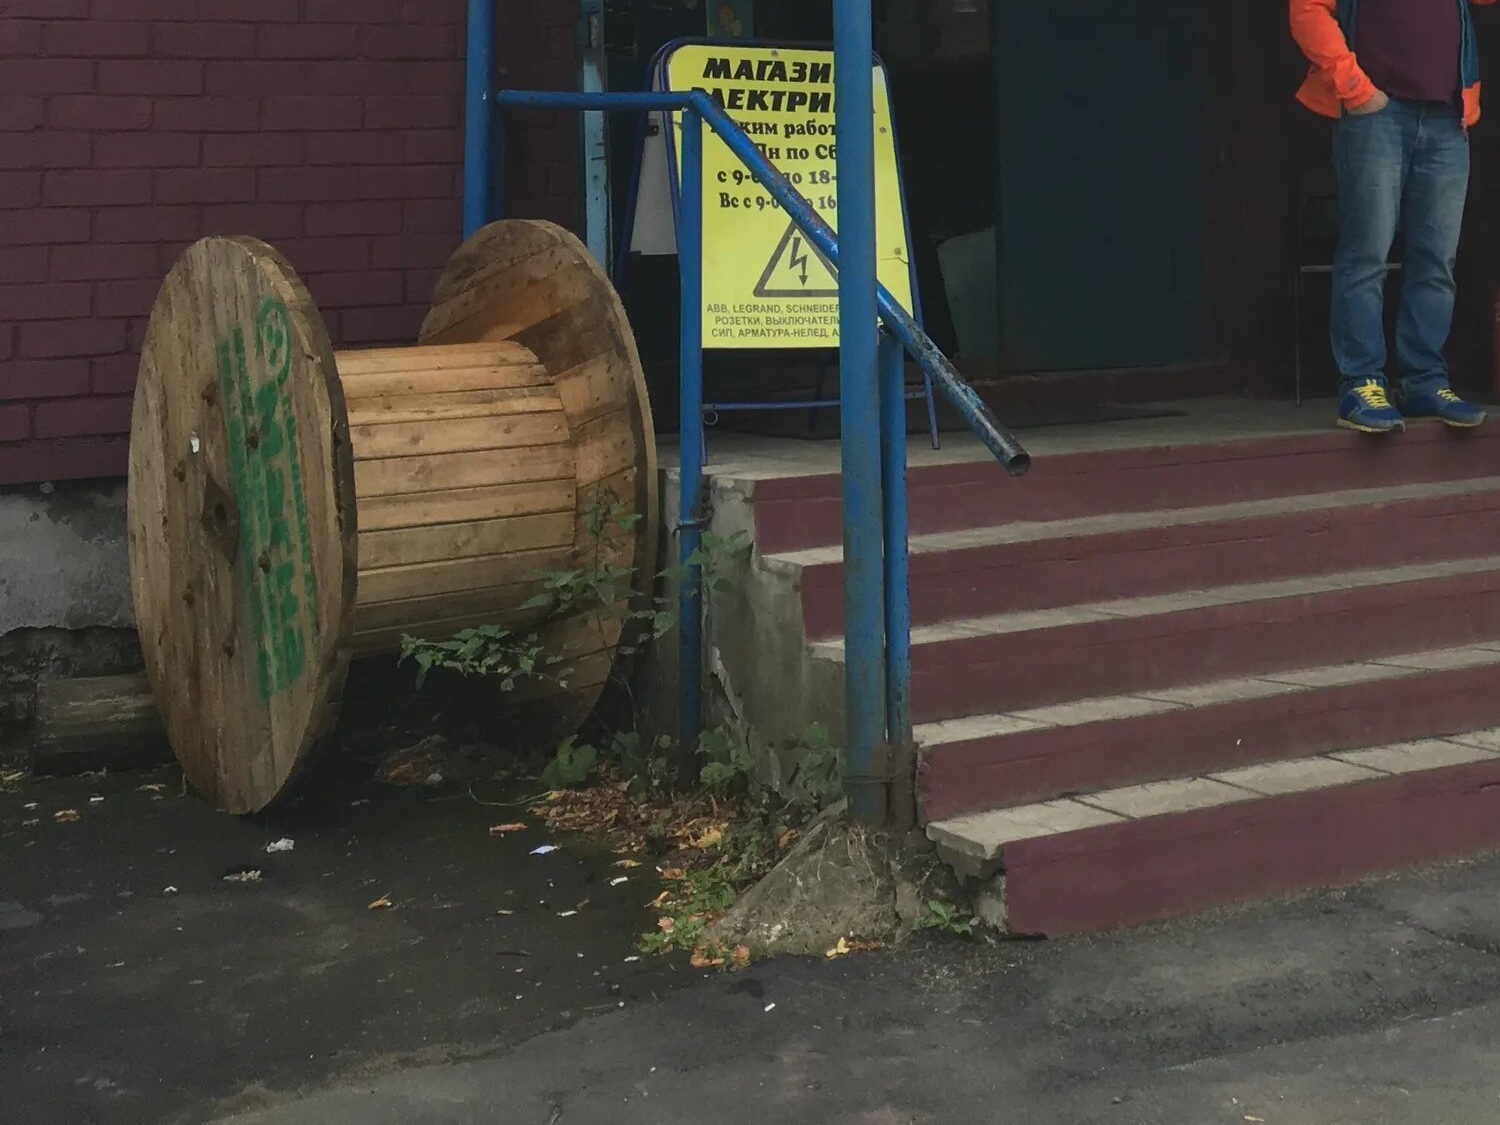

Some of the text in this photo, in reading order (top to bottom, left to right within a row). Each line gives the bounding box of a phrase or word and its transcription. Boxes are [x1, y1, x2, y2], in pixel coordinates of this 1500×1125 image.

[702, 58, 833, 83] МАГАЗИ
[784, 119, 837, 139] работ
[786, 147, 810, 160] по
[717, 171, 727, 182] с
[808, 170, 836, 184] 18-
[719, 192, 739, 209] Вс
[743, 196, 751, 208] с
[706, 304, 730, 314] ABB,
[732, 304, 783, 314] LEGRAND,
[715, 316, 763, 327] РОЗЕТКИ,
[712, 328, 735, 338] СИП,
